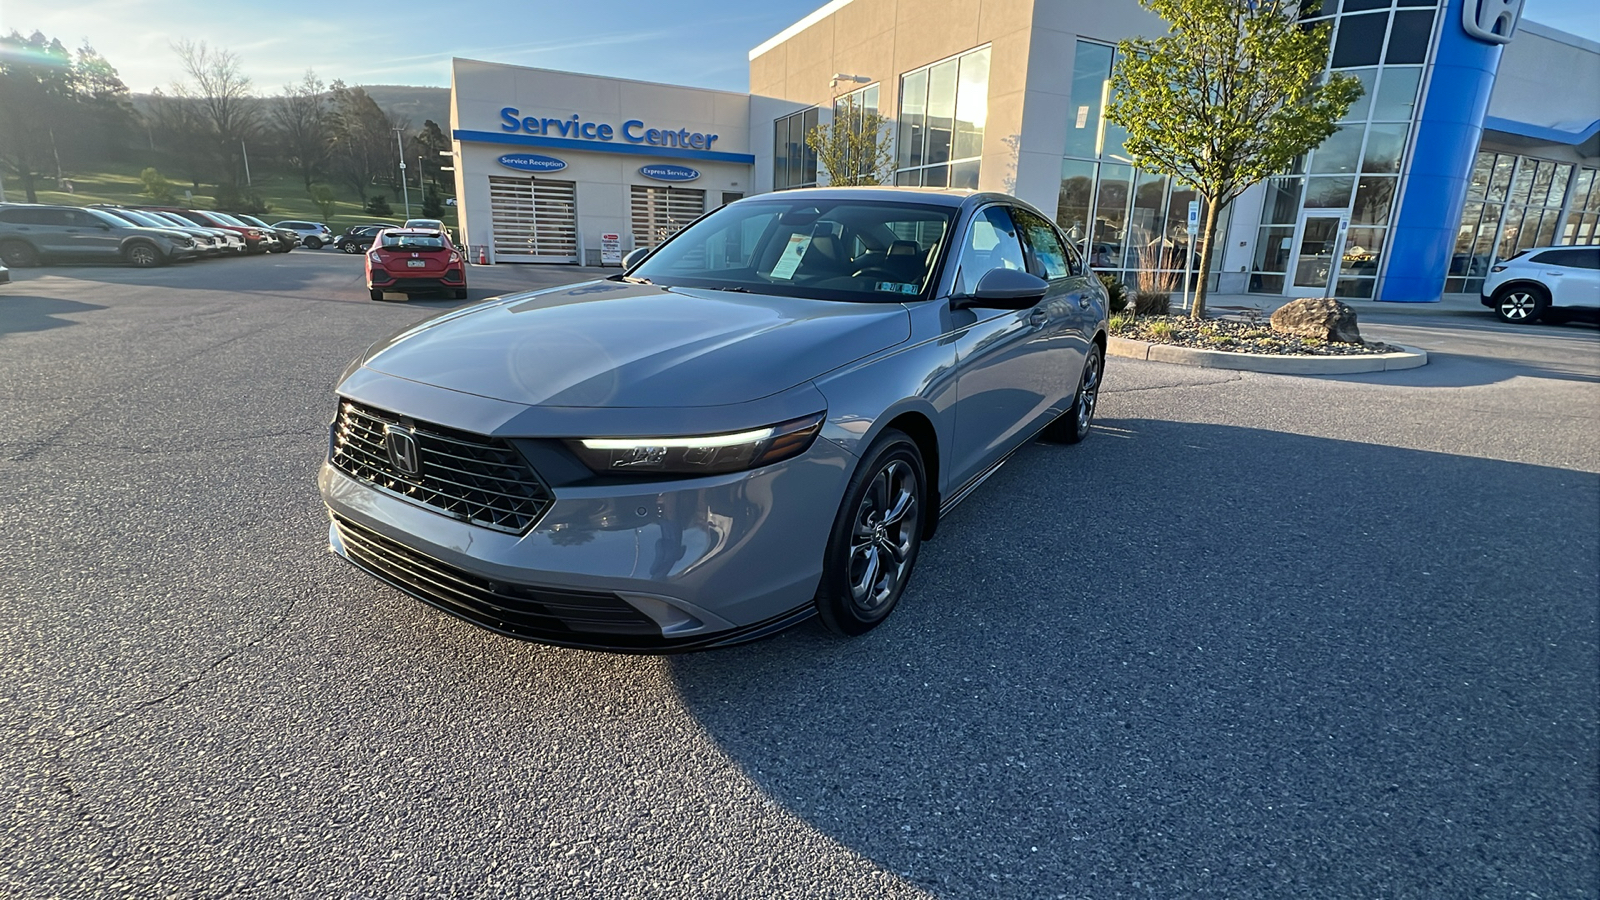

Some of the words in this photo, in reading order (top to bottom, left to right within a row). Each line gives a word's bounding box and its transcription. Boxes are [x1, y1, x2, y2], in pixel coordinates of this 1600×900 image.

[501, 107, 614, 141] Service
[622, 119, 719, 150] Center
[501, 157, 528, 166] Service
[529, 159, 564, 168] Reception
[643, 168, 666, 176] Express
[667, 169, 688, 177] Service
